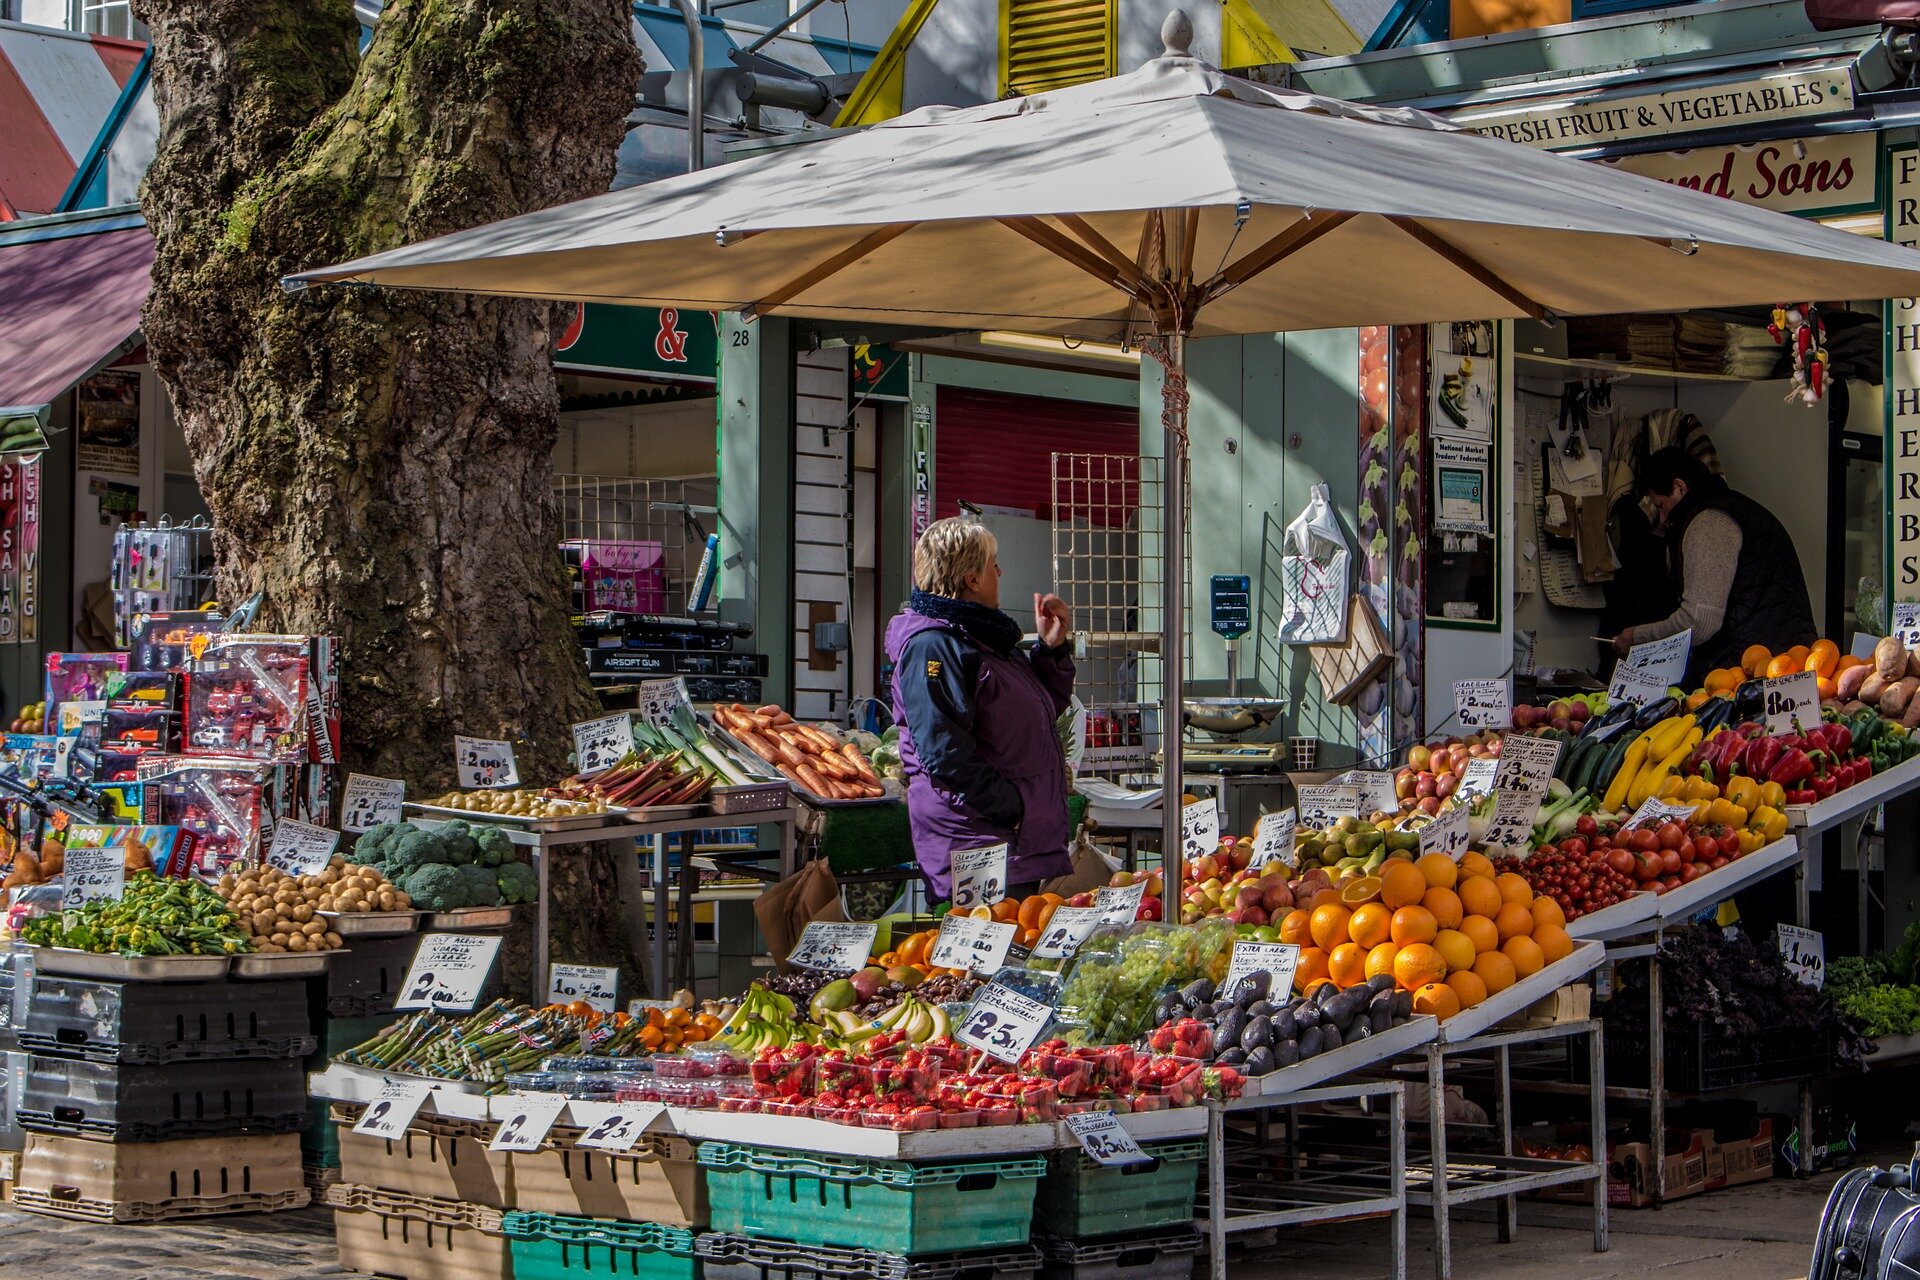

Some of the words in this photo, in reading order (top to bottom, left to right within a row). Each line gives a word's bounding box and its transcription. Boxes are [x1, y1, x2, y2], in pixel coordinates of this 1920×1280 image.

[1556, 108, 1629, 137] FRUIT
[1637, 106, 1657, 127] &
[1659, 81, 1824, 124] VEGETABLES
[1748, 146, 1854, 199] Sons
[1897, 157, 1920, 354] FRH
[655, 307, 688, 362] &
[733, 331, 749, 347] 28
[1439, 443, 1463, 453] National
[1465, 445, 1484, 454] Market
[1460, 454, 1487, 463] Federation
[916, 451, 928, 541] FRES
[1896, 387, 1920, 584] HERBS
[1436, 521, 1445, 529] BUY
[1460, 523, 1488, 532] CONFIDENCE
[0, 529, 13, 636] SALAD
[23, 552, 36, 617] VEG
[605, 658, 641, 667] AIRSOFT
[642, 659, 660, 667] GUN
[605, 715, 627, 725] TASTY
[351, 777, 390, 788] BROCCOLI
[67, 850, 104, 858] NORFOLK
[956, 876, 975, 905] 5
[432, 946, 470, 954] NORFOLK
[985, 995, 1040, 1023] STRAWBERRIES
[988, 984, 1007, 997] RIPE
[1014, 996, 1043, 1012] SWEET
